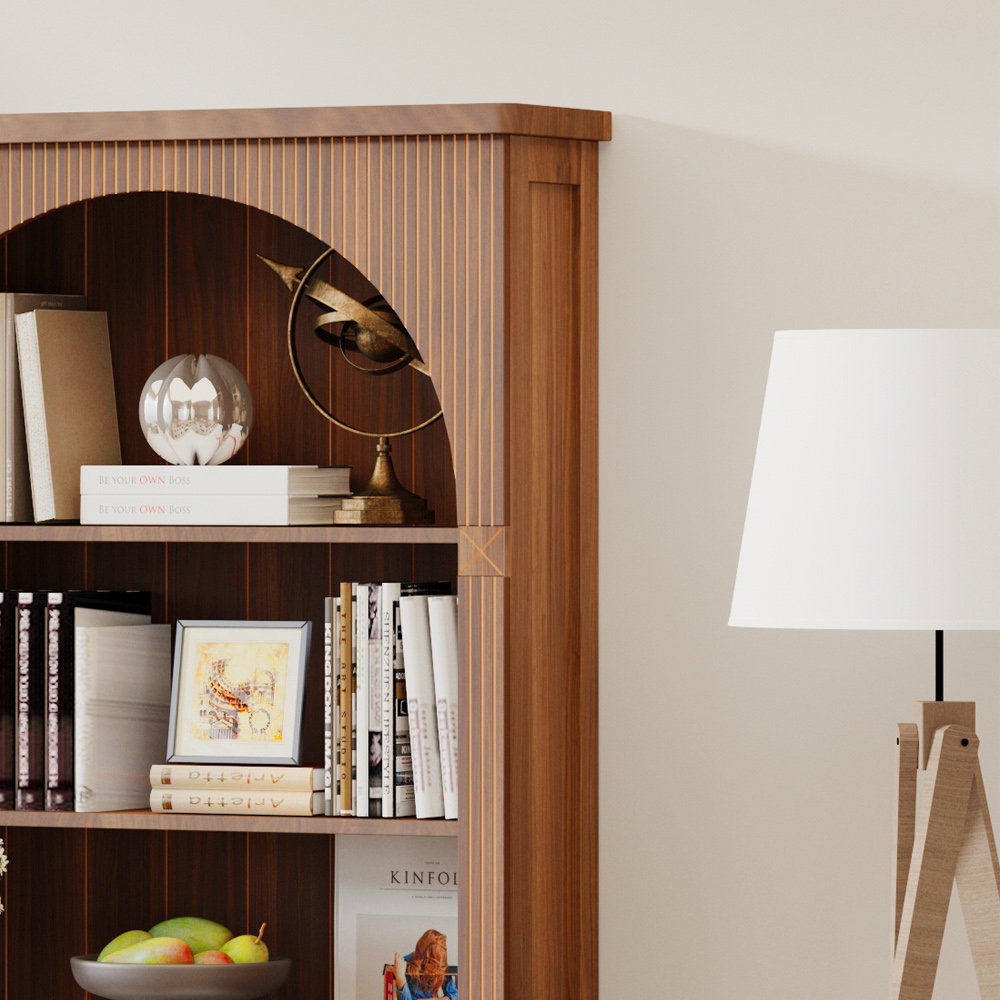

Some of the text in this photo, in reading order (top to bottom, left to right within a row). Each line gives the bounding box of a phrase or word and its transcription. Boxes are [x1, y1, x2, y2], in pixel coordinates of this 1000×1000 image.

[139, 475, 166, 485] OWN
[139, 505, 166, 514] OWN
[324, 622, 332, 800] KINGDOM IMAGE
[188, 771, 285, 785] Arletta
[189, 796, 285, 809] Arletta
